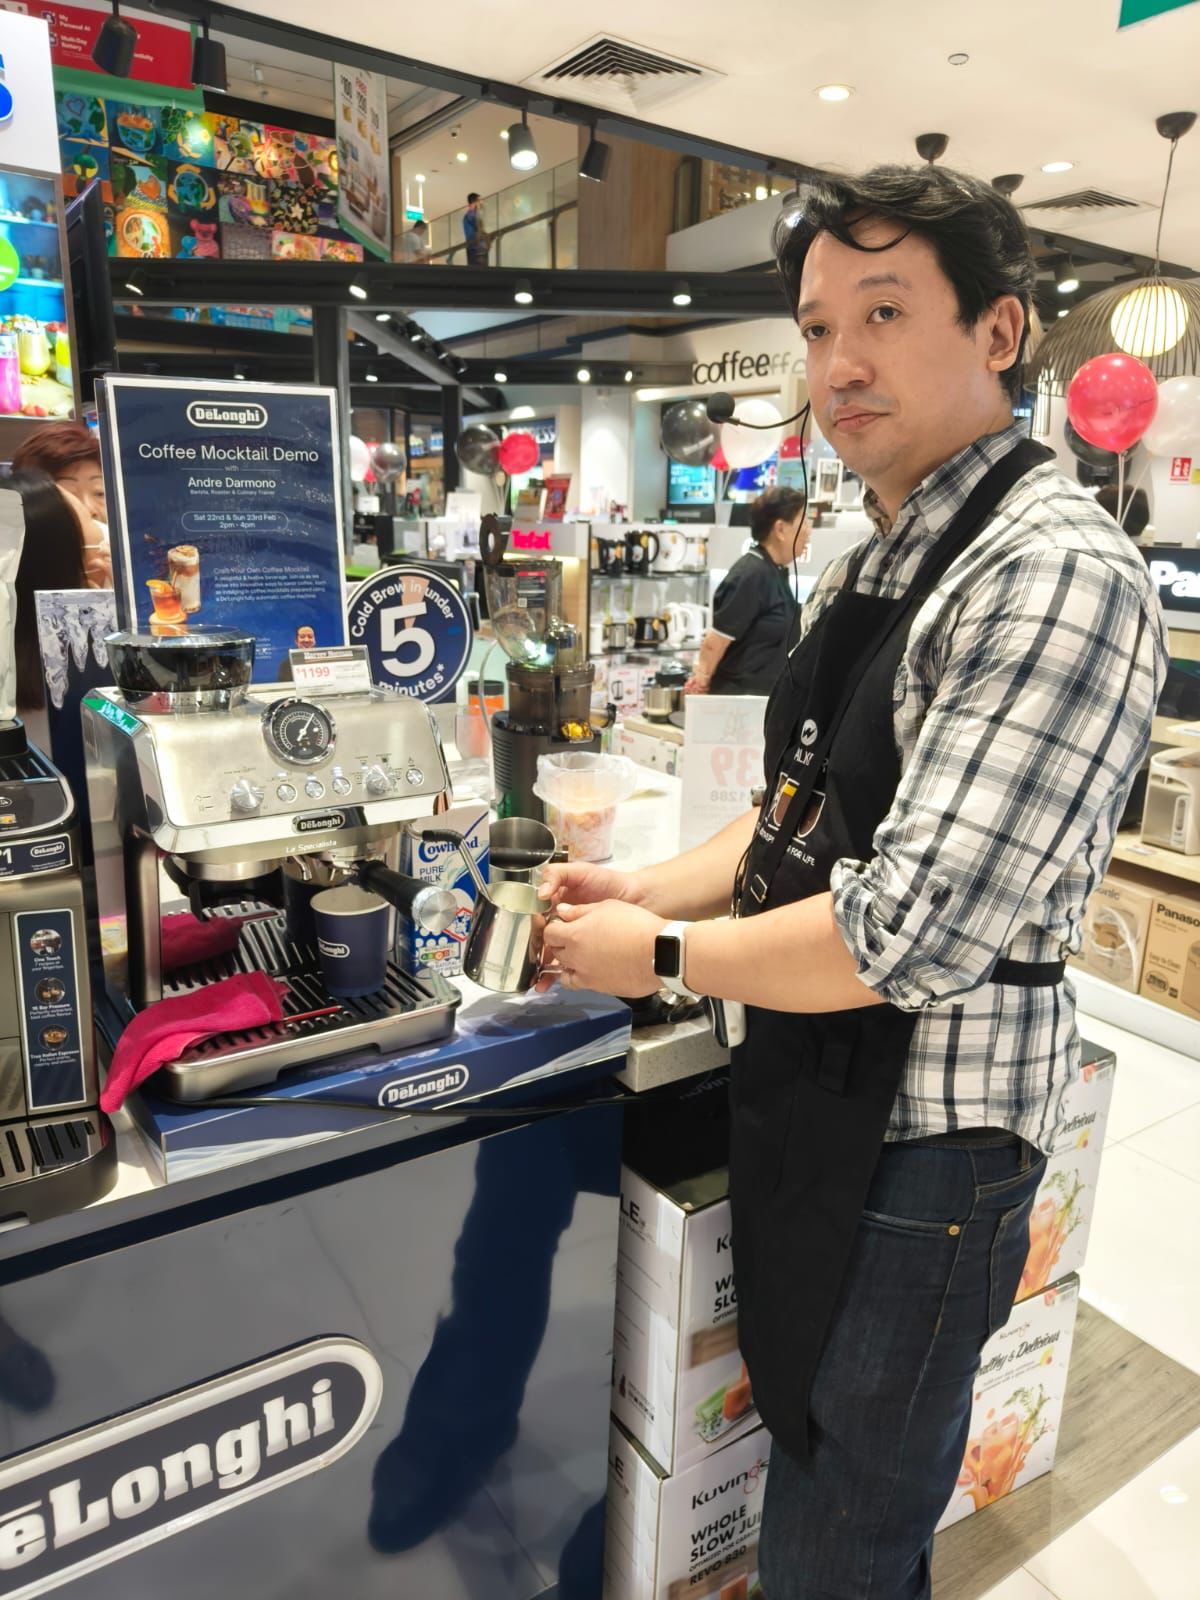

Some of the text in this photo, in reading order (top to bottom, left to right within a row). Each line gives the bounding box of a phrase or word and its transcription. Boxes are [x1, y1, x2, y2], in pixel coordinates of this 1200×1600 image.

[694, 350, 771, 385] coffee
[138, 443, 320, 463] Coffee Mocktail Demo
[224, 464, 240, 473] with
[187, 477, 277, 489] Andre Darmono
[219, 521, 236, 530] 2pm
[240, 521, 256, 530] 4pm
[264, 513, 277, 521] Feb
[351, 578, 455, 638] Cold Brew in under
[380, 601, 436, 678] 5
[802, 853, 816, 866] LIFE
[420, 865, 445, 876] PURE
[691, 1504, 747, 1546] WHOLE
[690, 1526, 736, 1562] SLOW
[690, 1560, 722, 1586] REVO
